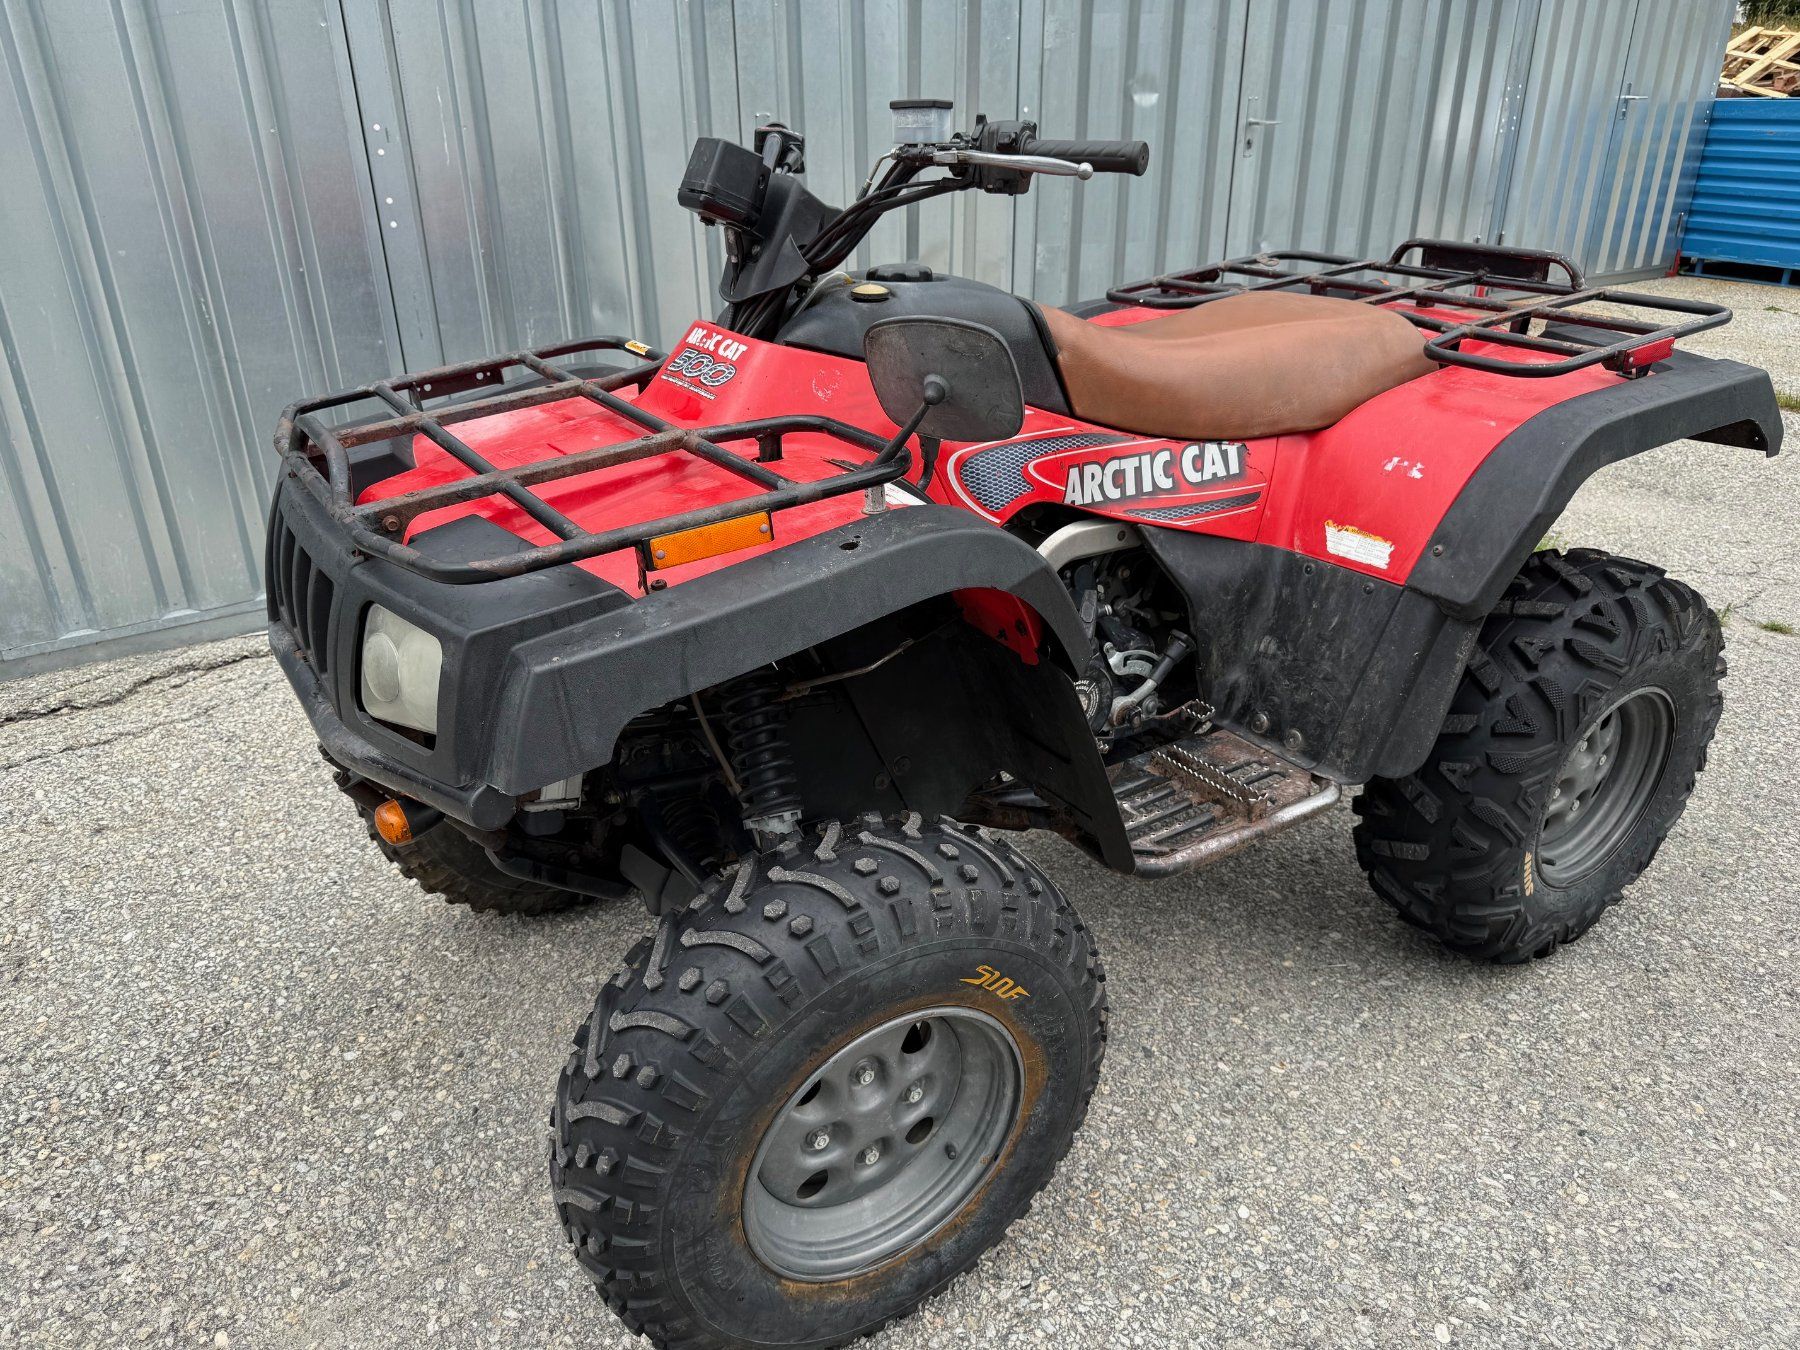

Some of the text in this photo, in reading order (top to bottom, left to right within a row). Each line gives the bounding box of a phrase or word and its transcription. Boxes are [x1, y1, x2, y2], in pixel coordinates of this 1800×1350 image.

[666, 346, 737, 387] 500
[717, 338, 749, 362] CAT
[1063, 441, 1244, 506] ARCTIC CAT
